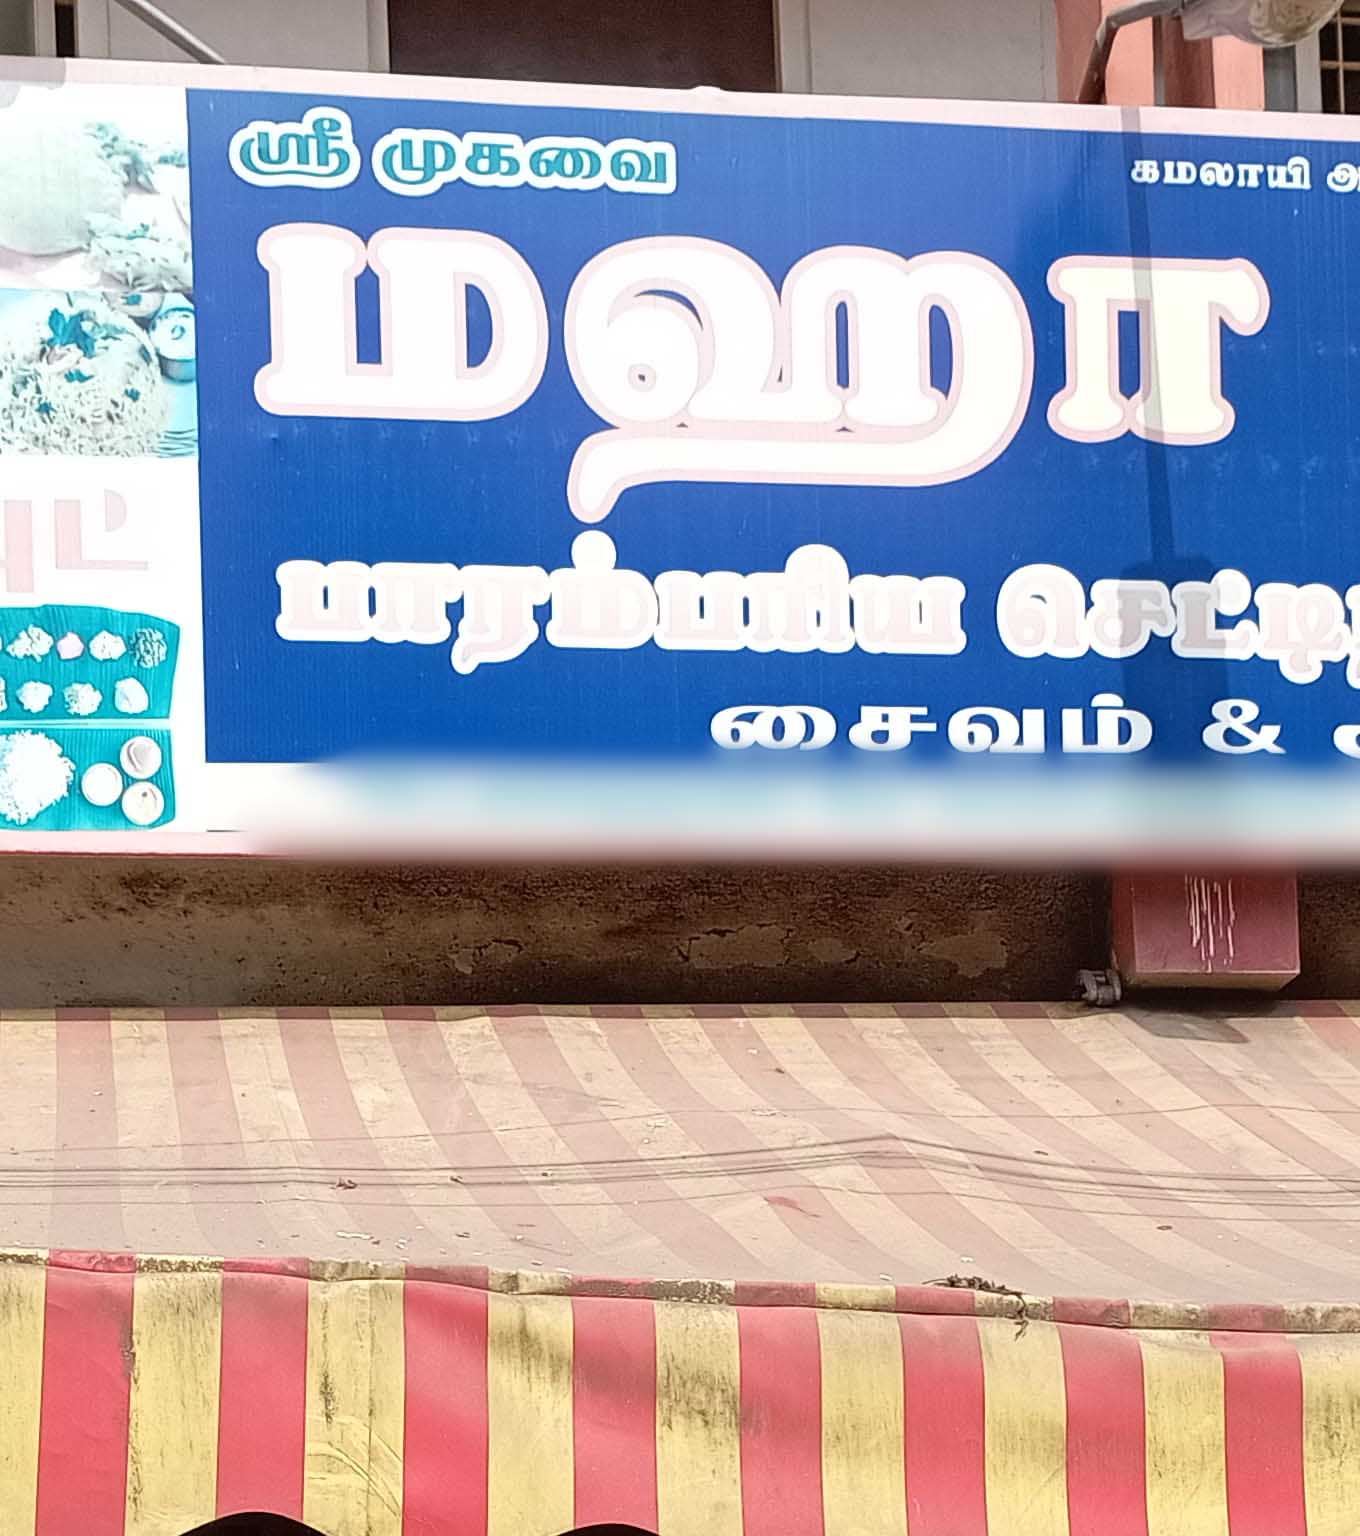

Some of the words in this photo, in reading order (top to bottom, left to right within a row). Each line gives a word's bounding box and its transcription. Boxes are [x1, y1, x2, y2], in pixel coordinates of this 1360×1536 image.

[372, 128, 677, 197] முகவை
[1131, 155, 1312, 191] கமலாயி
[255, 222, 1271, 523] மஹா
[275, 530, 967, 674] பாரம்பரிய
[710, 693, 1153, 754] சைவம்
[1201, 698, 1286, 757] &
